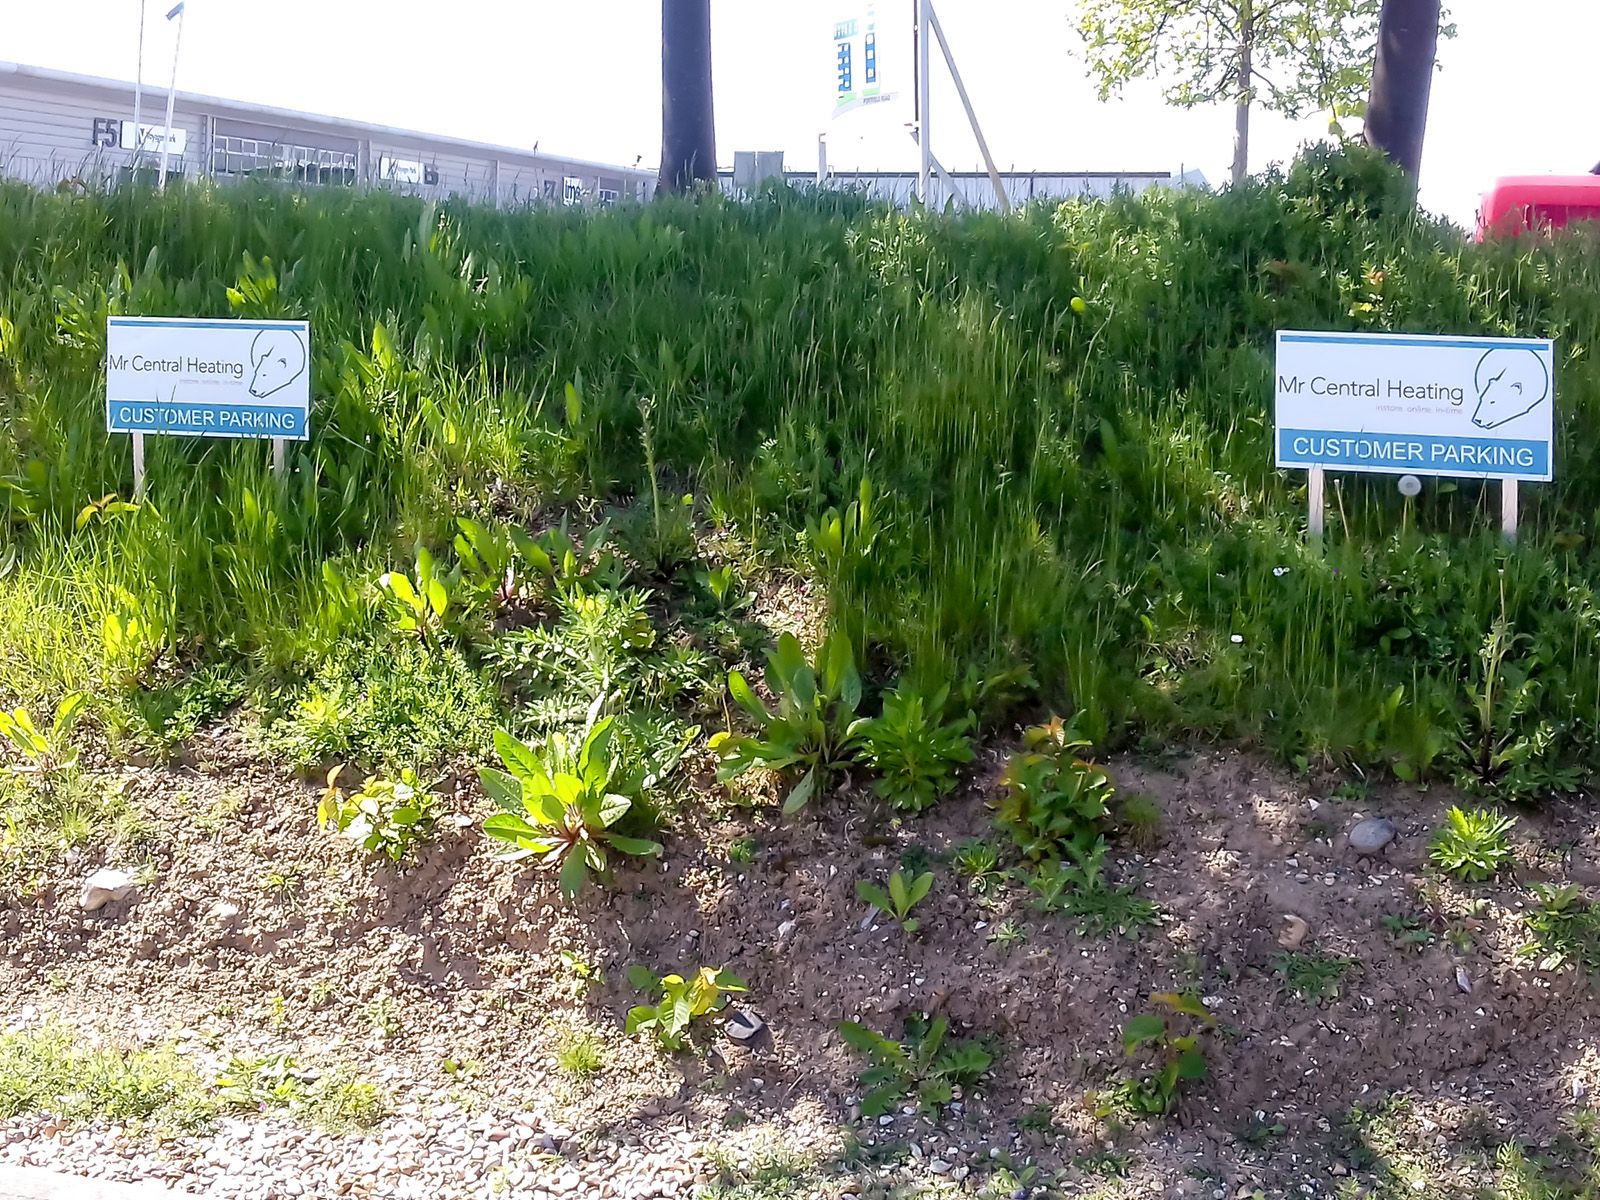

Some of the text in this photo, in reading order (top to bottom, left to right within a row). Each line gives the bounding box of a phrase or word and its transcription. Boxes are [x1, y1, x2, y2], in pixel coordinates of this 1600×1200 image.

[92, 117, 118, 148] F5
[109, 355, 244, 379] Mr Central Heating
[1278, 375, 1464, 406] Mr Central Heating
[119, 406, 296, 430] CUSTOMER PARKING
[1293, 436, 1535, 467] CUSTOMER PARKING
